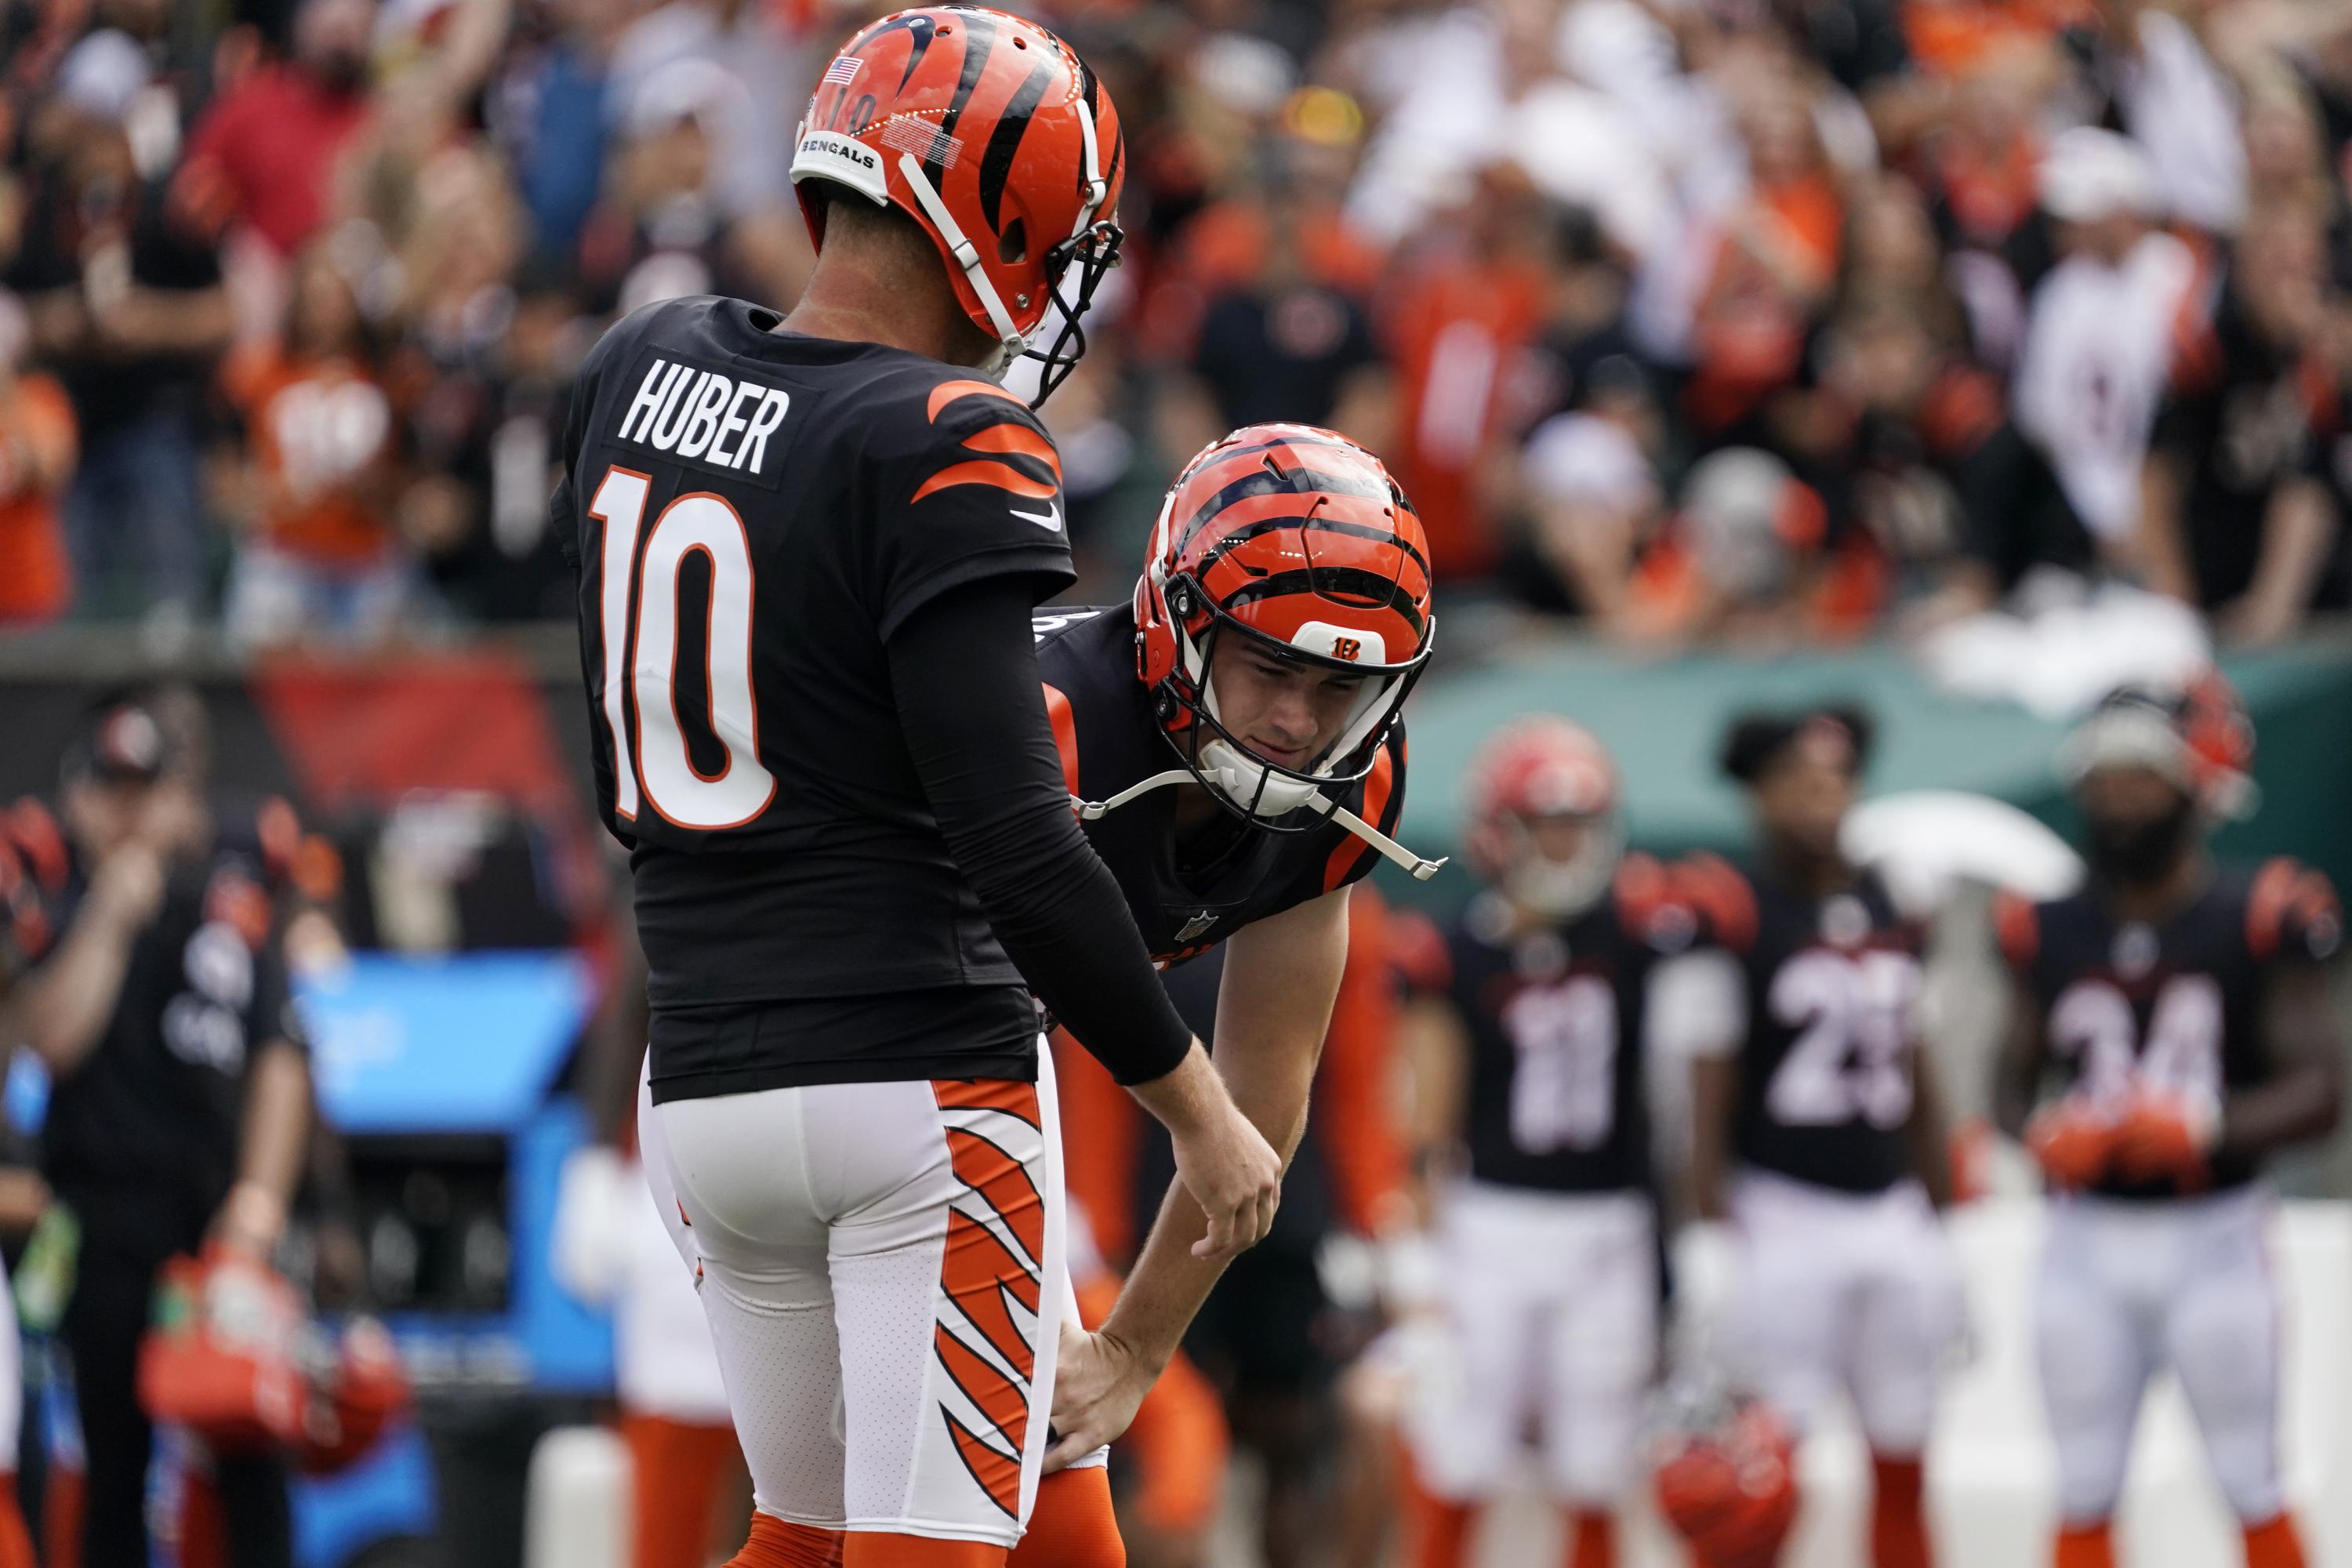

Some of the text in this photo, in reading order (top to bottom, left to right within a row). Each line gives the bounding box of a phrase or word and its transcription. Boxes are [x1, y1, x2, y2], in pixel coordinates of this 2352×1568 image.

[801, 140, 875, 169] BENGALS
[618, 358, 790, 474] HUBER
[587, 463, 777, 831] 10
